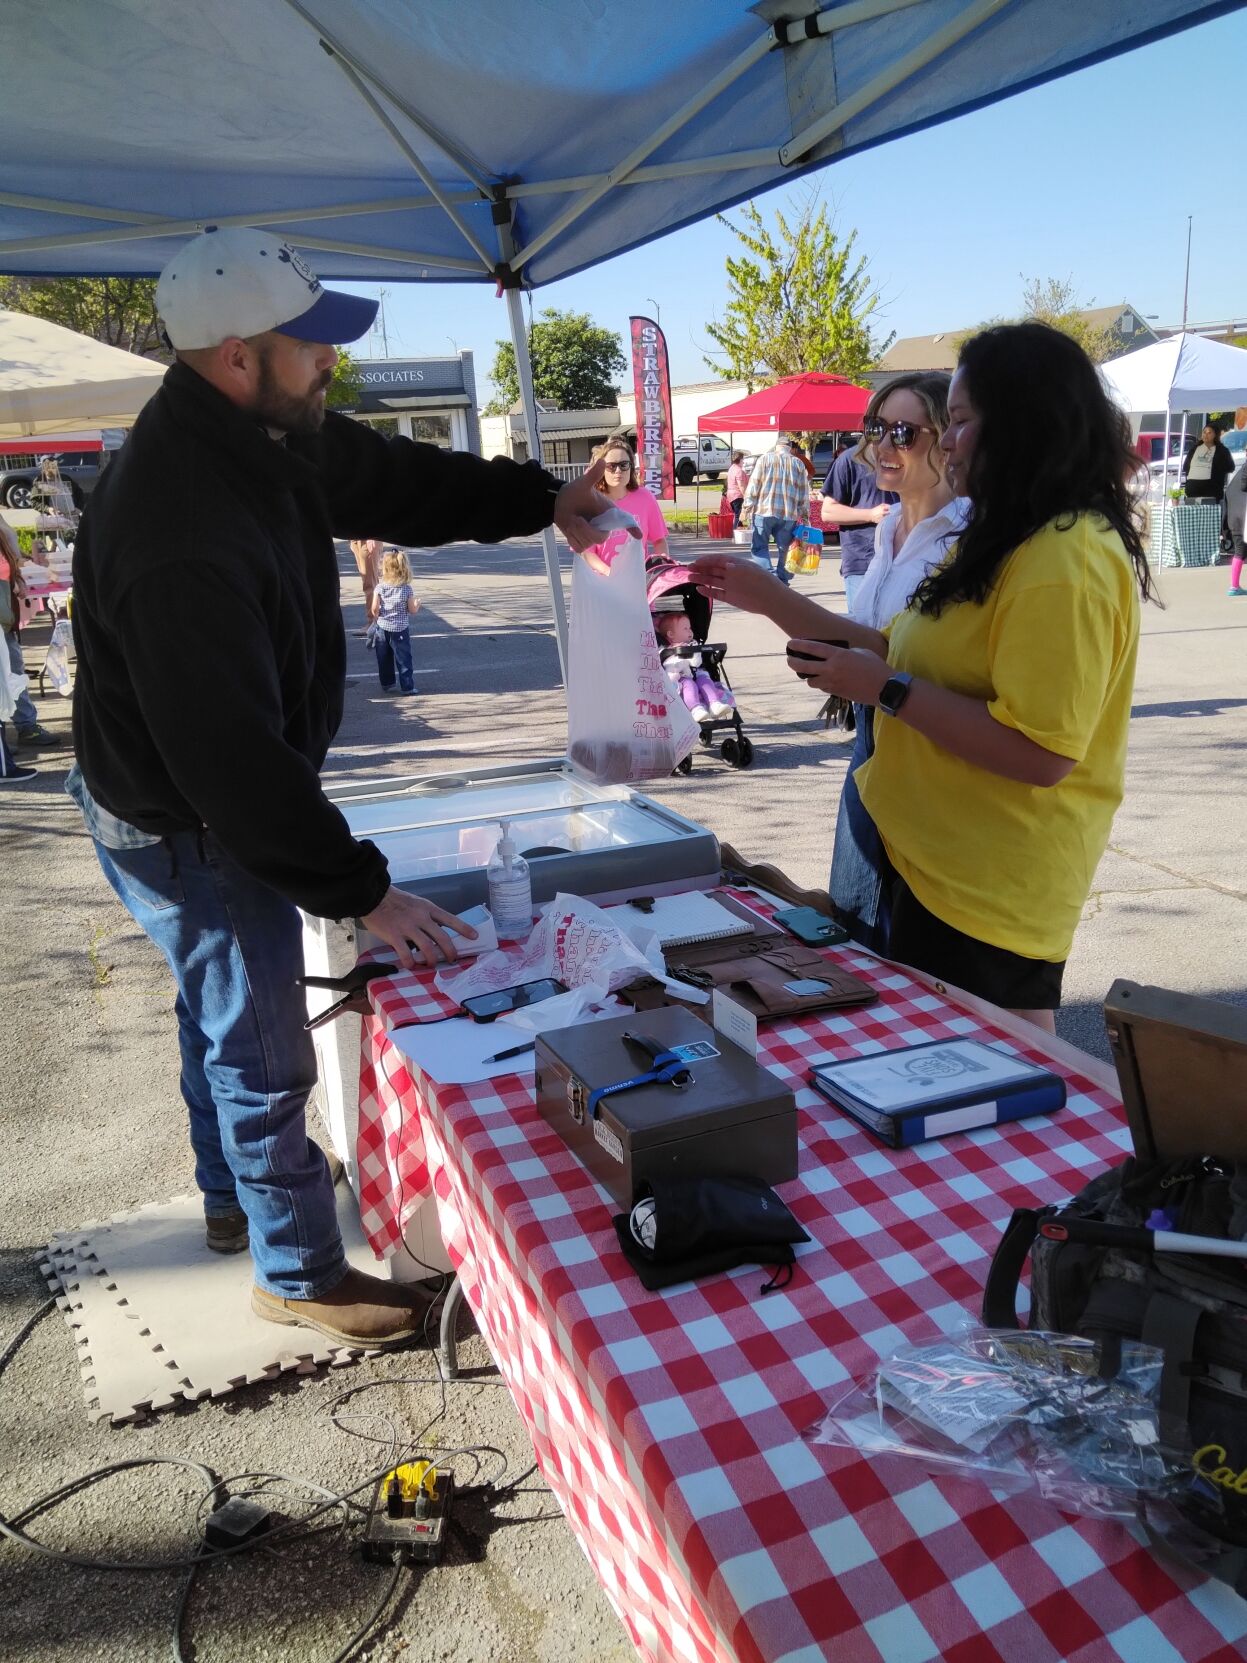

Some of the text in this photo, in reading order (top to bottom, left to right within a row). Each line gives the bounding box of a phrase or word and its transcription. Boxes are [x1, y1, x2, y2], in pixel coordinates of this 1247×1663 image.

[350, 371, 424, 384] ASSOCIATES
[642, 326, 662, 497] STRAWBERRIES
[603, 1080, 634, 1093] venmo
